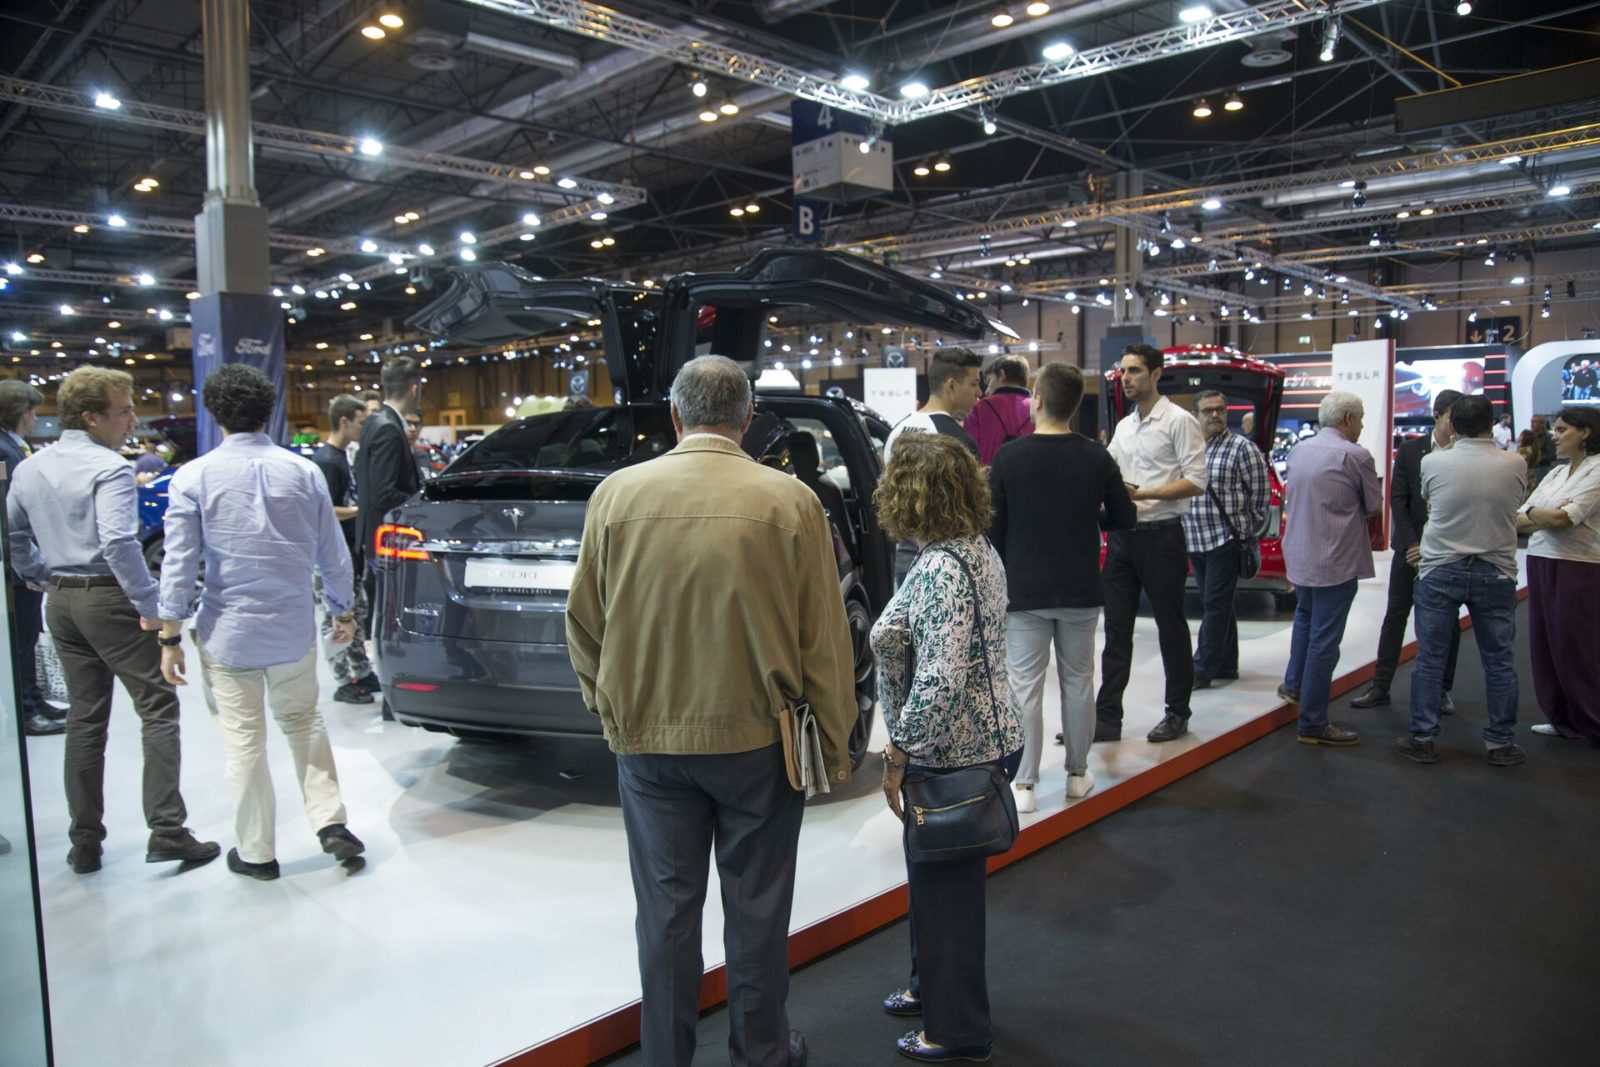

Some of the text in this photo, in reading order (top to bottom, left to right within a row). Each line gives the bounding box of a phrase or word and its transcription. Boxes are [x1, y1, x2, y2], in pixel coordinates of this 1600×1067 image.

[817, 104, 834, 129] 4
[799, 205, 815, 235] B
[1503, 325, 1516, 342] 2
[234, 337, 273, 355] Ford
[1337, 370, 1380, 381] TESLA
